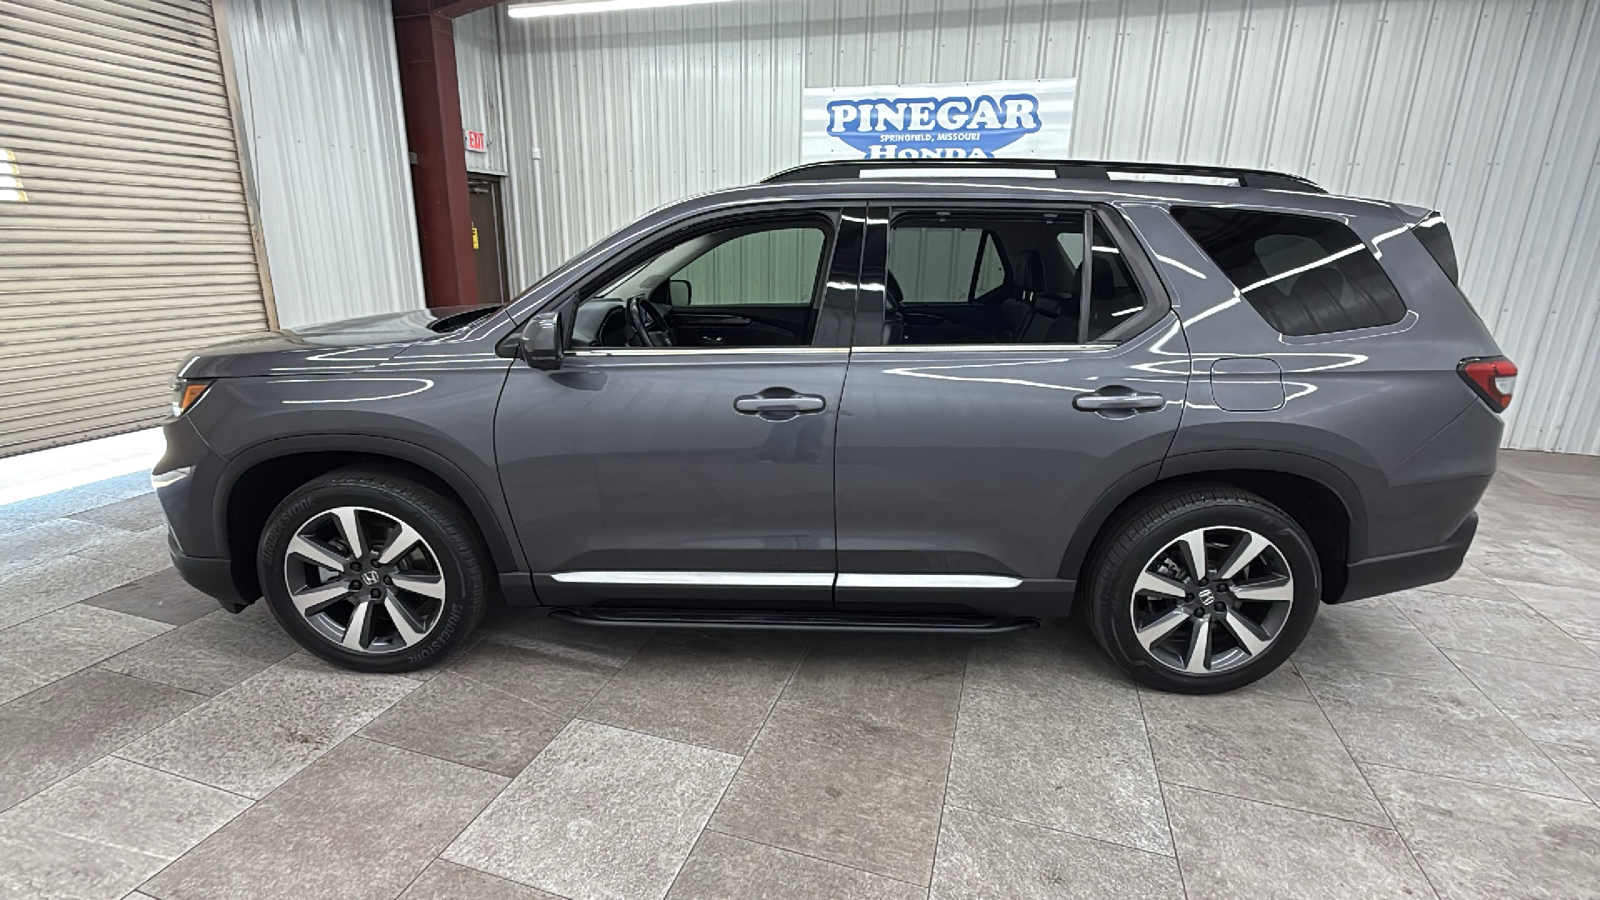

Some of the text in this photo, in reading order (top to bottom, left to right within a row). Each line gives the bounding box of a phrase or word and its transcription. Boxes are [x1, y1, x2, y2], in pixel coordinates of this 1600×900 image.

[830, 99, 1037, 132] PINEGAR
[468, 131, 484, 151] EXIT
[880, 133, 981, 143] SPRINGFIELD, MISSOURI
